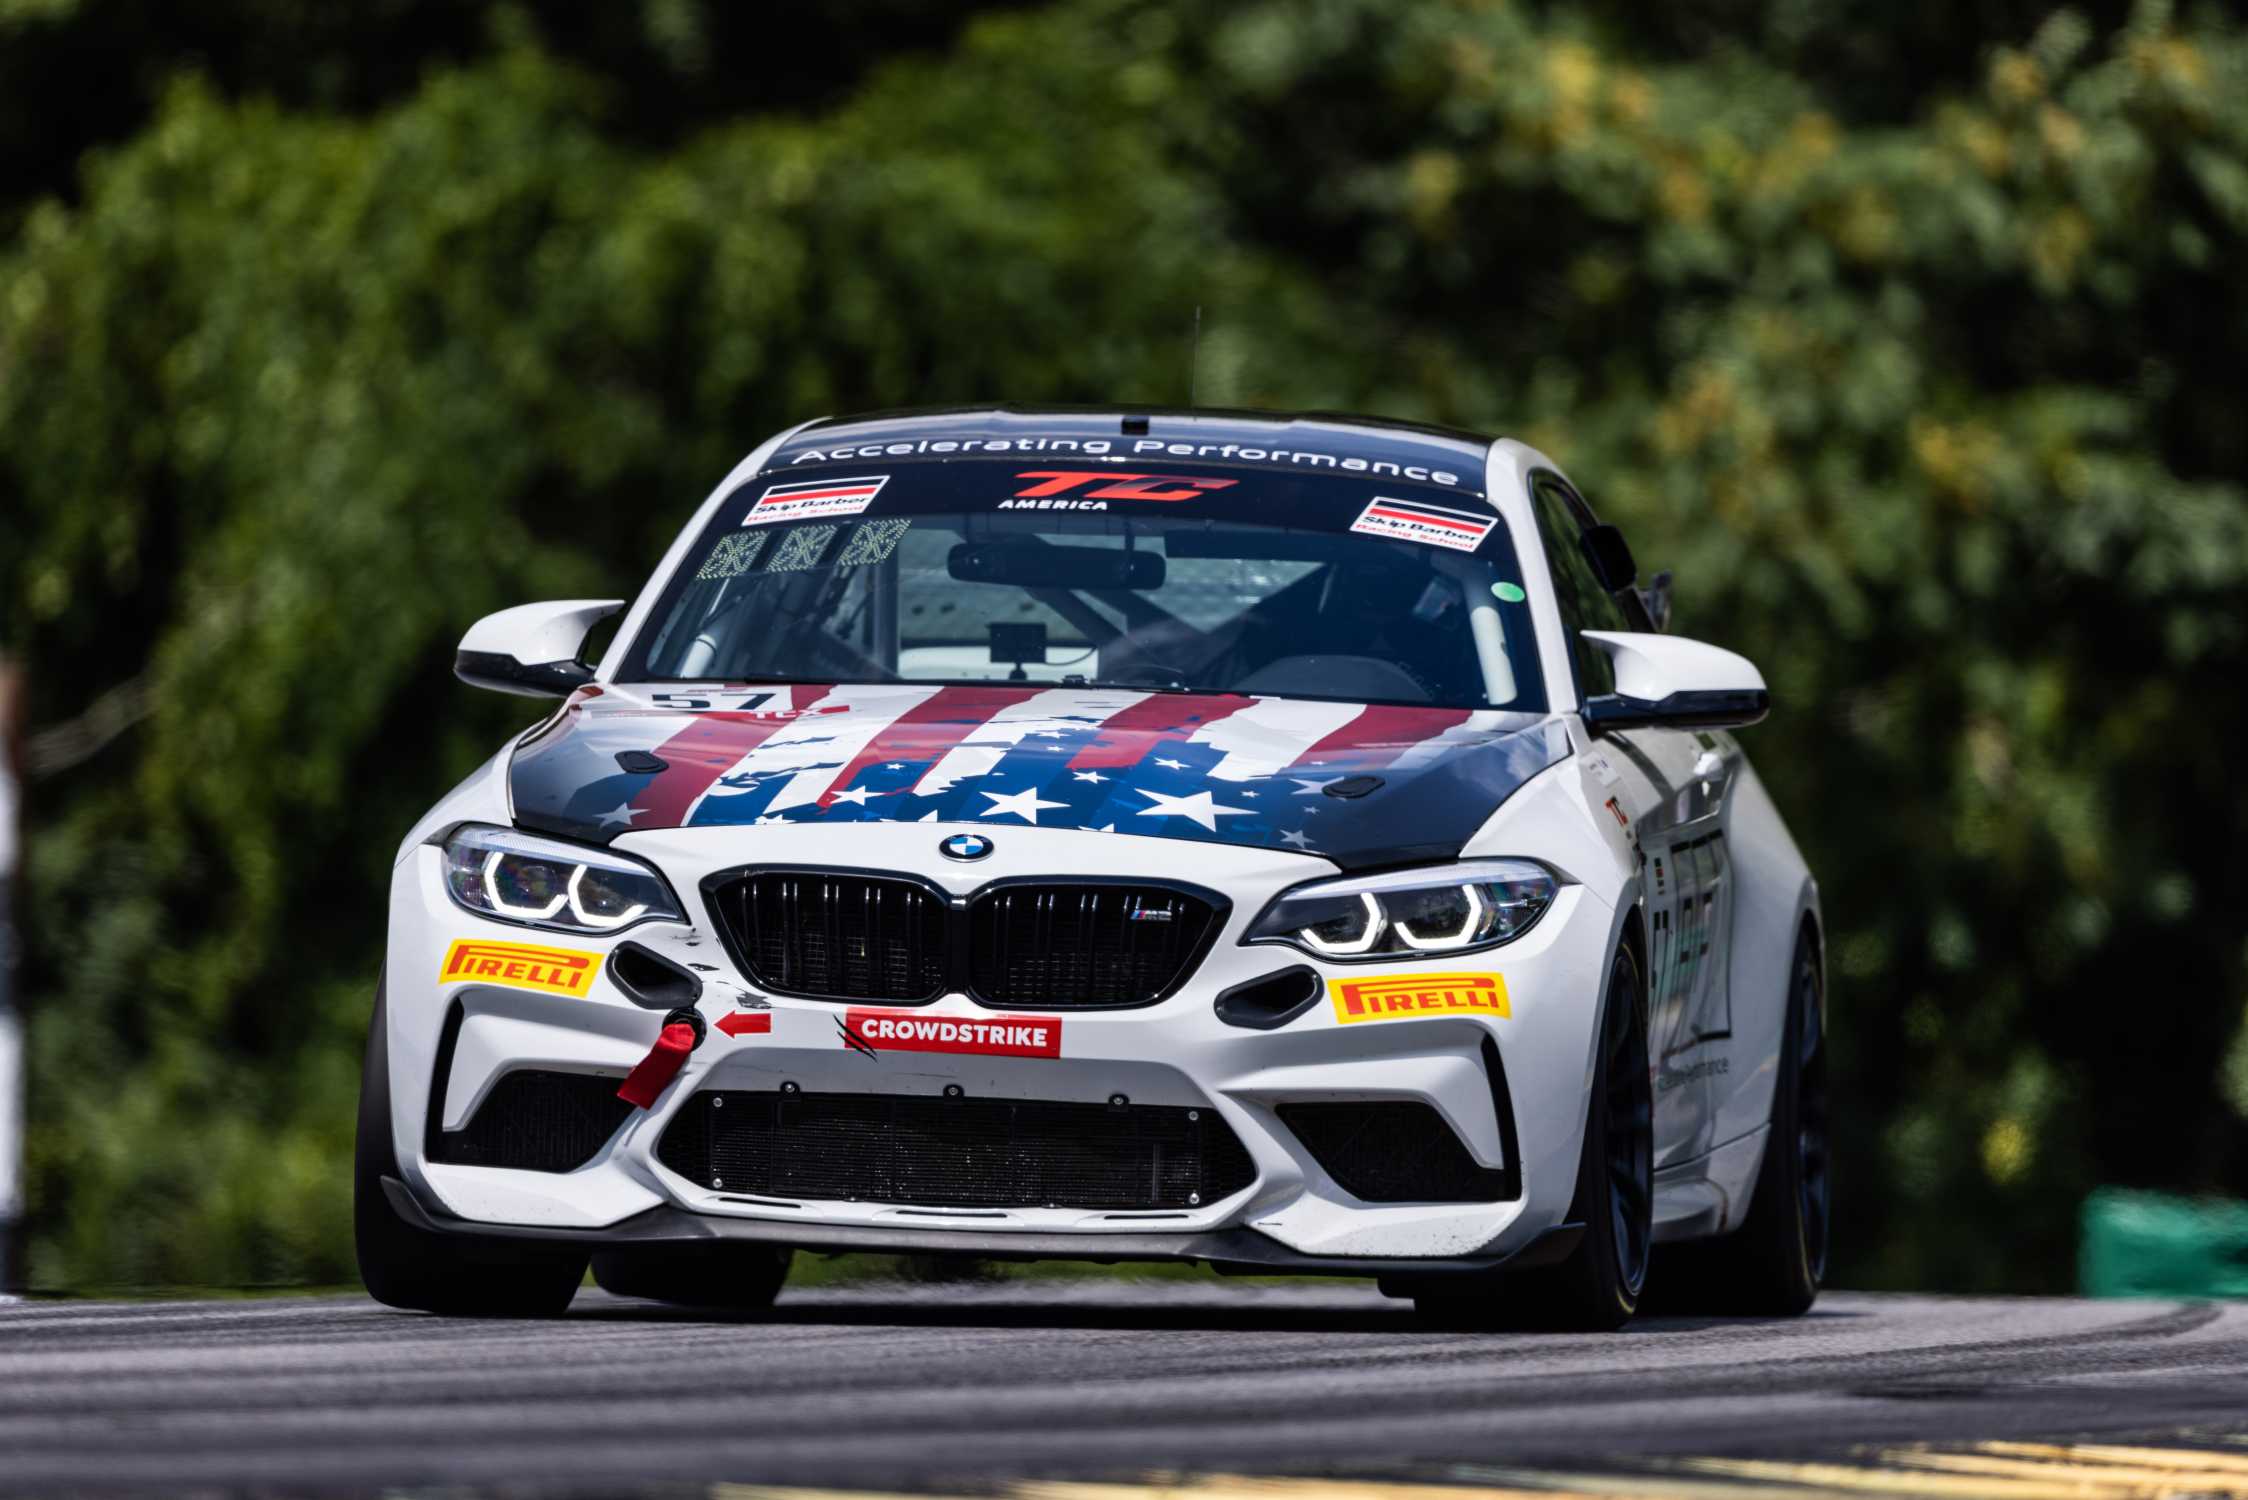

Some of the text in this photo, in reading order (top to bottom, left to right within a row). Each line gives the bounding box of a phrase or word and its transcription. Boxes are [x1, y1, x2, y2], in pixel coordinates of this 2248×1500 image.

[792, 438, 1459, 487] Accelerating Performance
[800, 496, 870, 508] Barber
[998, 500, 1108, 511] AMERICA
[1356, 523, 1474, 549] Racing School
[1363, 516, 1479, 542] Skip Barber
[651, 693, 776, 710] 57
[447, 944, 590, 989] PIRELLI
[1340, 977, 1499, 1016] PIRELLI
[861, 1019, 1048, 1047] CROWDSTRIKE
